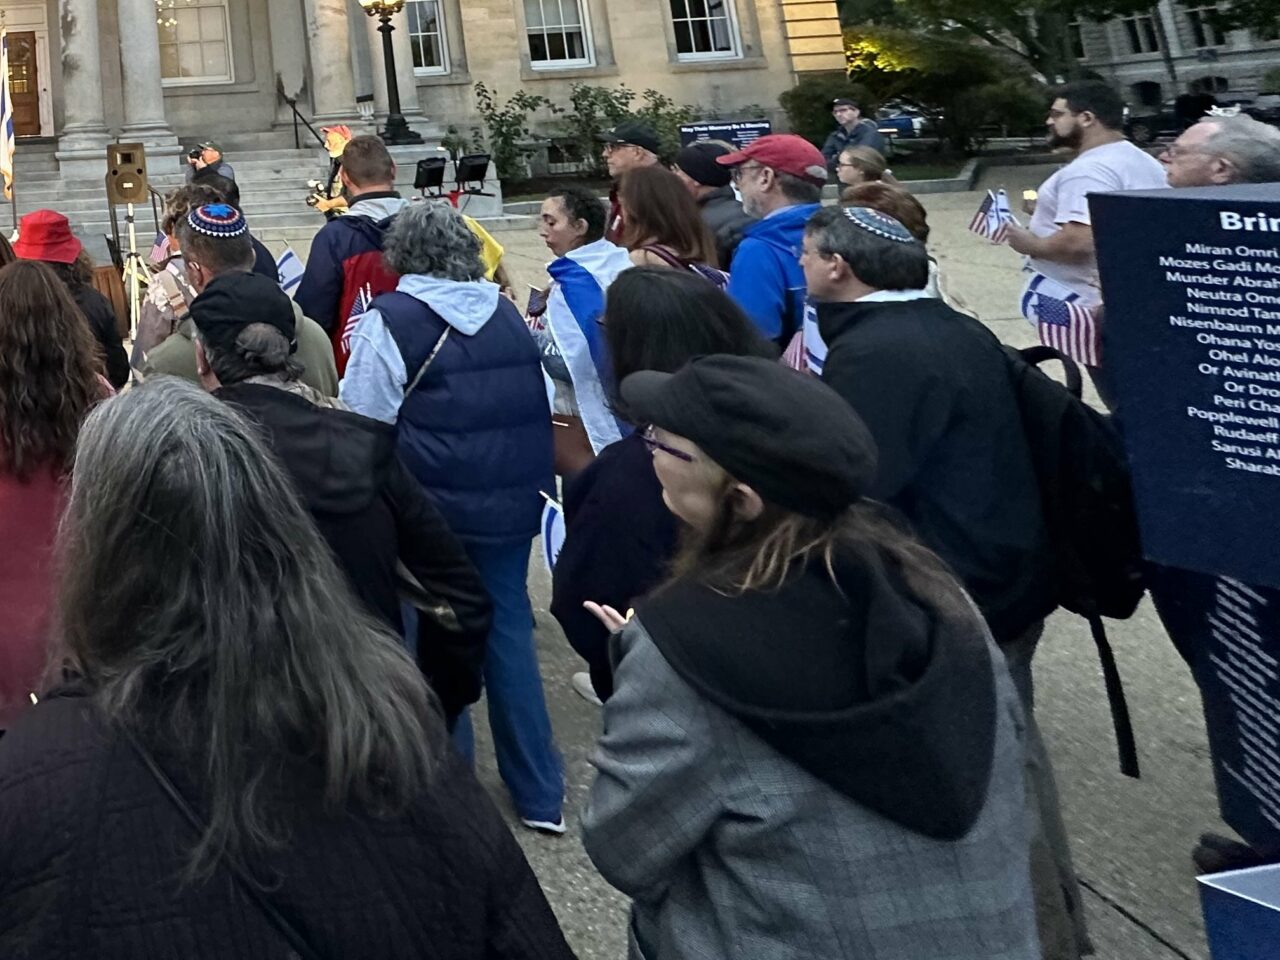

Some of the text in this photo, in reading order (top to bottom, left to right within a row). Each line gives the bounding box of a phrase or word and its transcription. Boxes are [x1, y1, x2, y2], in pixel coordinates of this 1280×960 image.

[1185, 243, 1280, 258] Miran Omri
[1159, 256, 1210, 270] Mozes
[1212, 260, 1252, 272] Gadi
[1166, 271, 1230, 286] Munder
[1186, 287, 1242, 302] Neutra
[1186, 302, 1249, 318] Nimrod
[1169, 315, 1263, 334] Nisenbaum
[1196, 333, 1252, 348] Ohana
[1208, 349, 1248, 363] Ohel
[1198, 362, 1220, 375] Or
[1224, 381, 1246, 393] Or
[1214, 394, 1246, 408] Peri
[1187, 406, 1279, 428] Popplewell
[1213, 424, 1278, 444] Rudaeff
[1211, 440, 1262, 457] Sarusi
